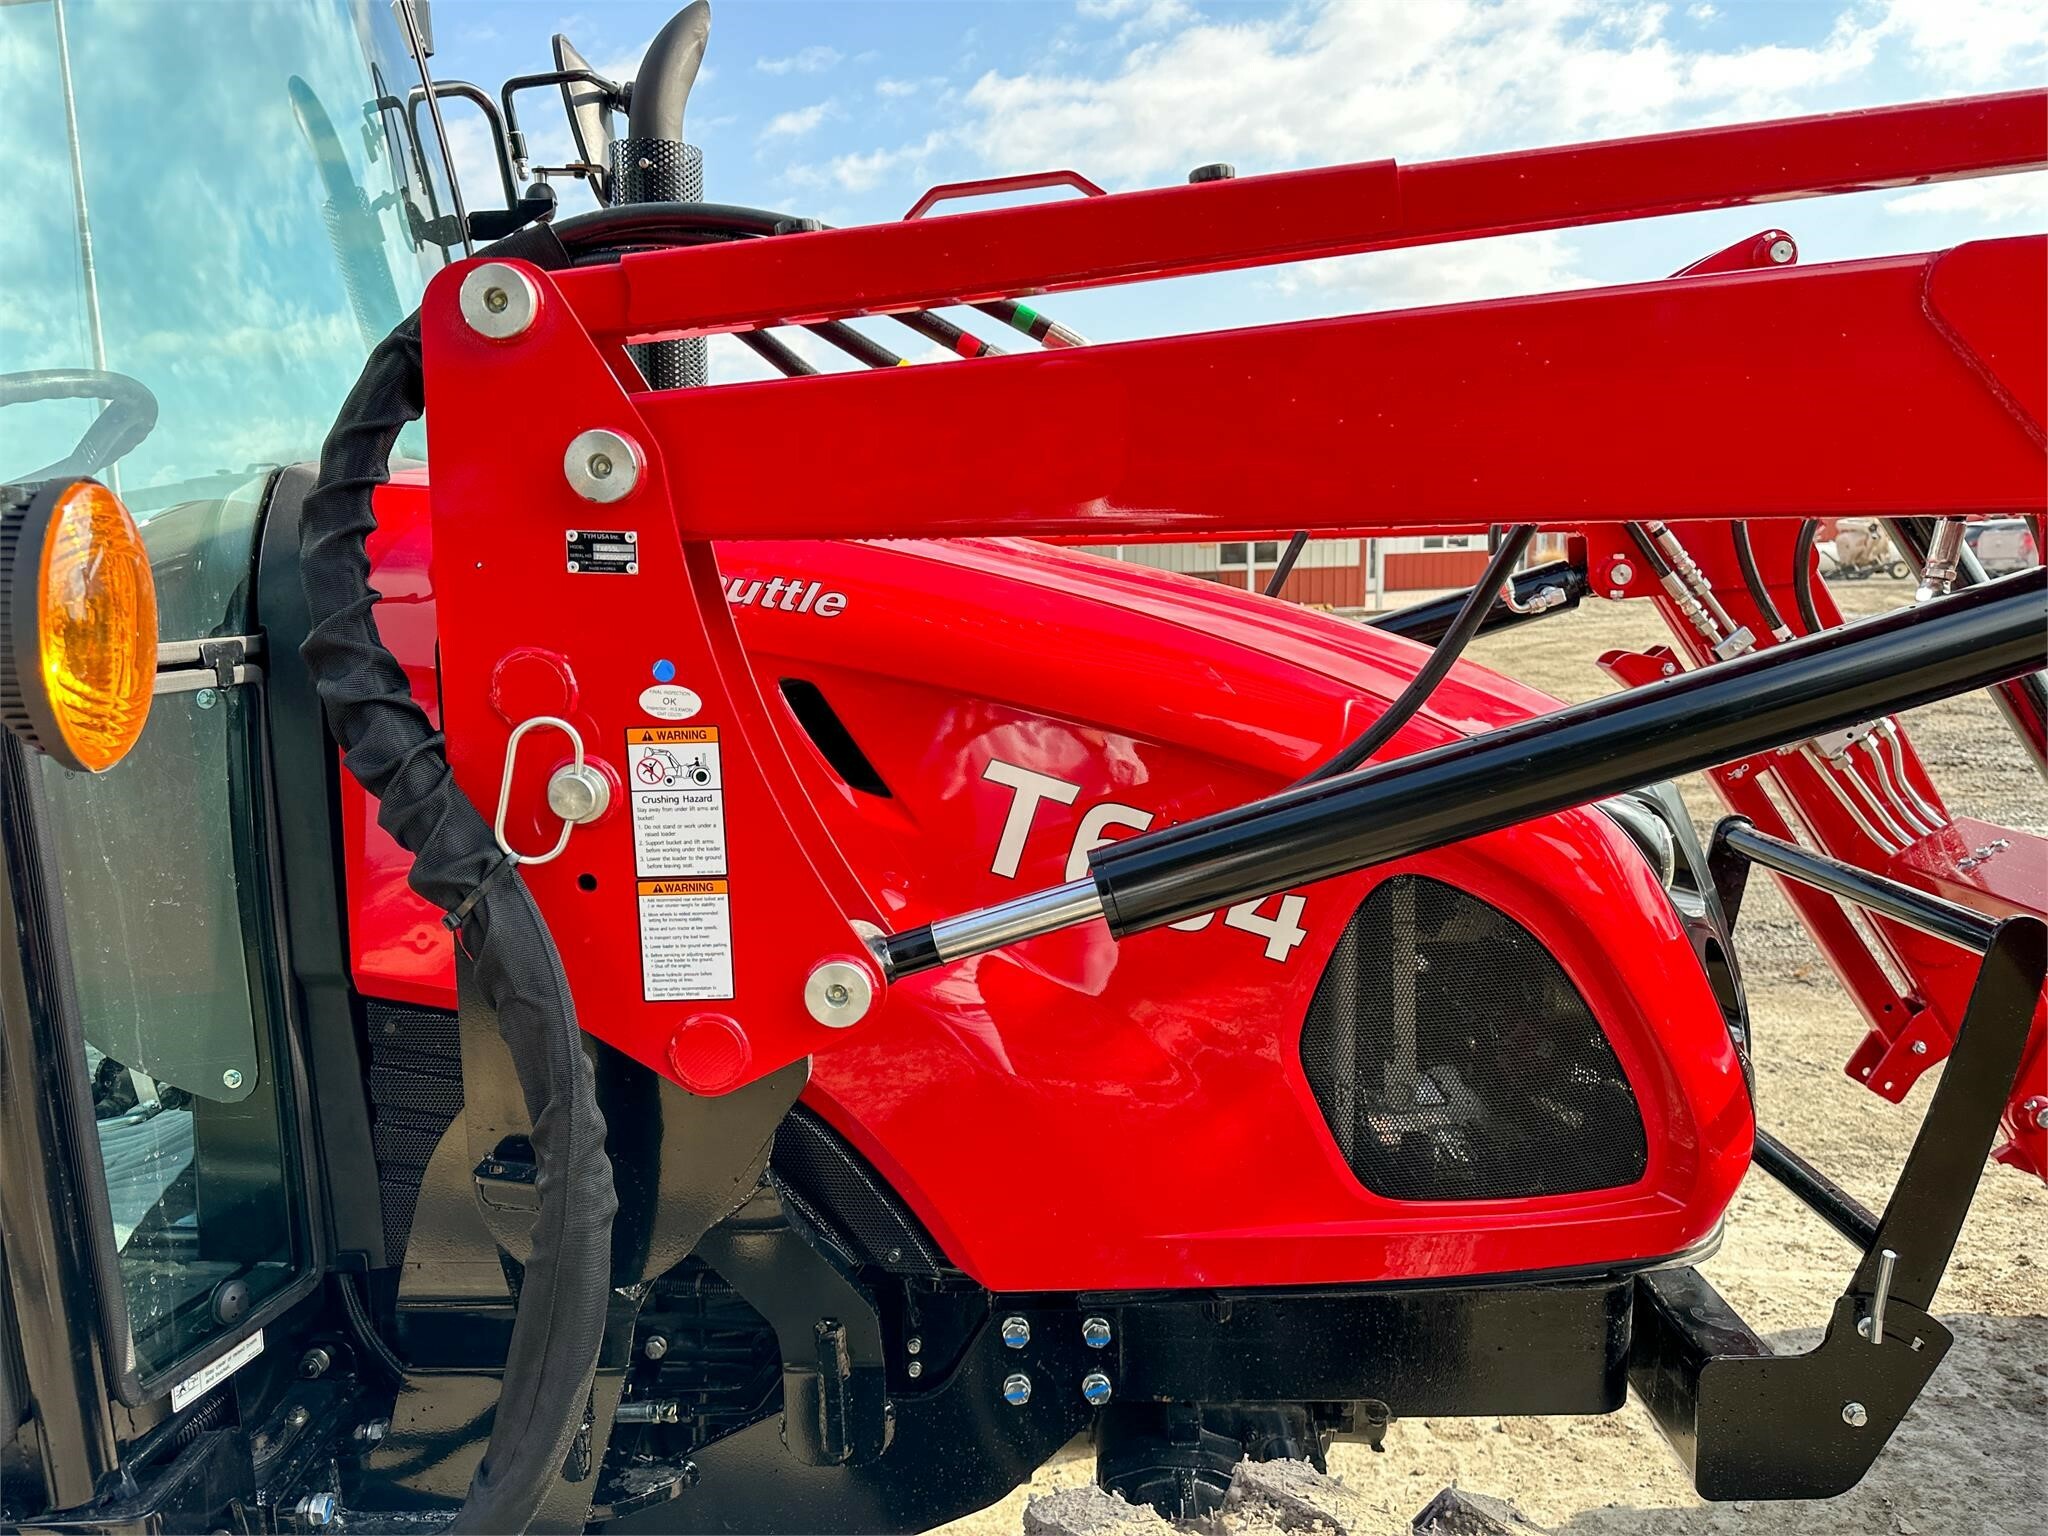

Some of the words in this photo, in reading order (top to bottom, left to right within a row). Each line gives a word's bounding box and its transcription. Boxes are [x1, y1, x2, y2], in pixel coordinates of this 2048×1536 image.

[720, 575, 848, 617] uttle
[663, 697, 676, 705] OK
[656, 730, 707, 740] WARNING
[642, 795, 680, 805] Crushing
[982, 758, 1308, 963] T64
[665, 883, 713, 892] WARNING
